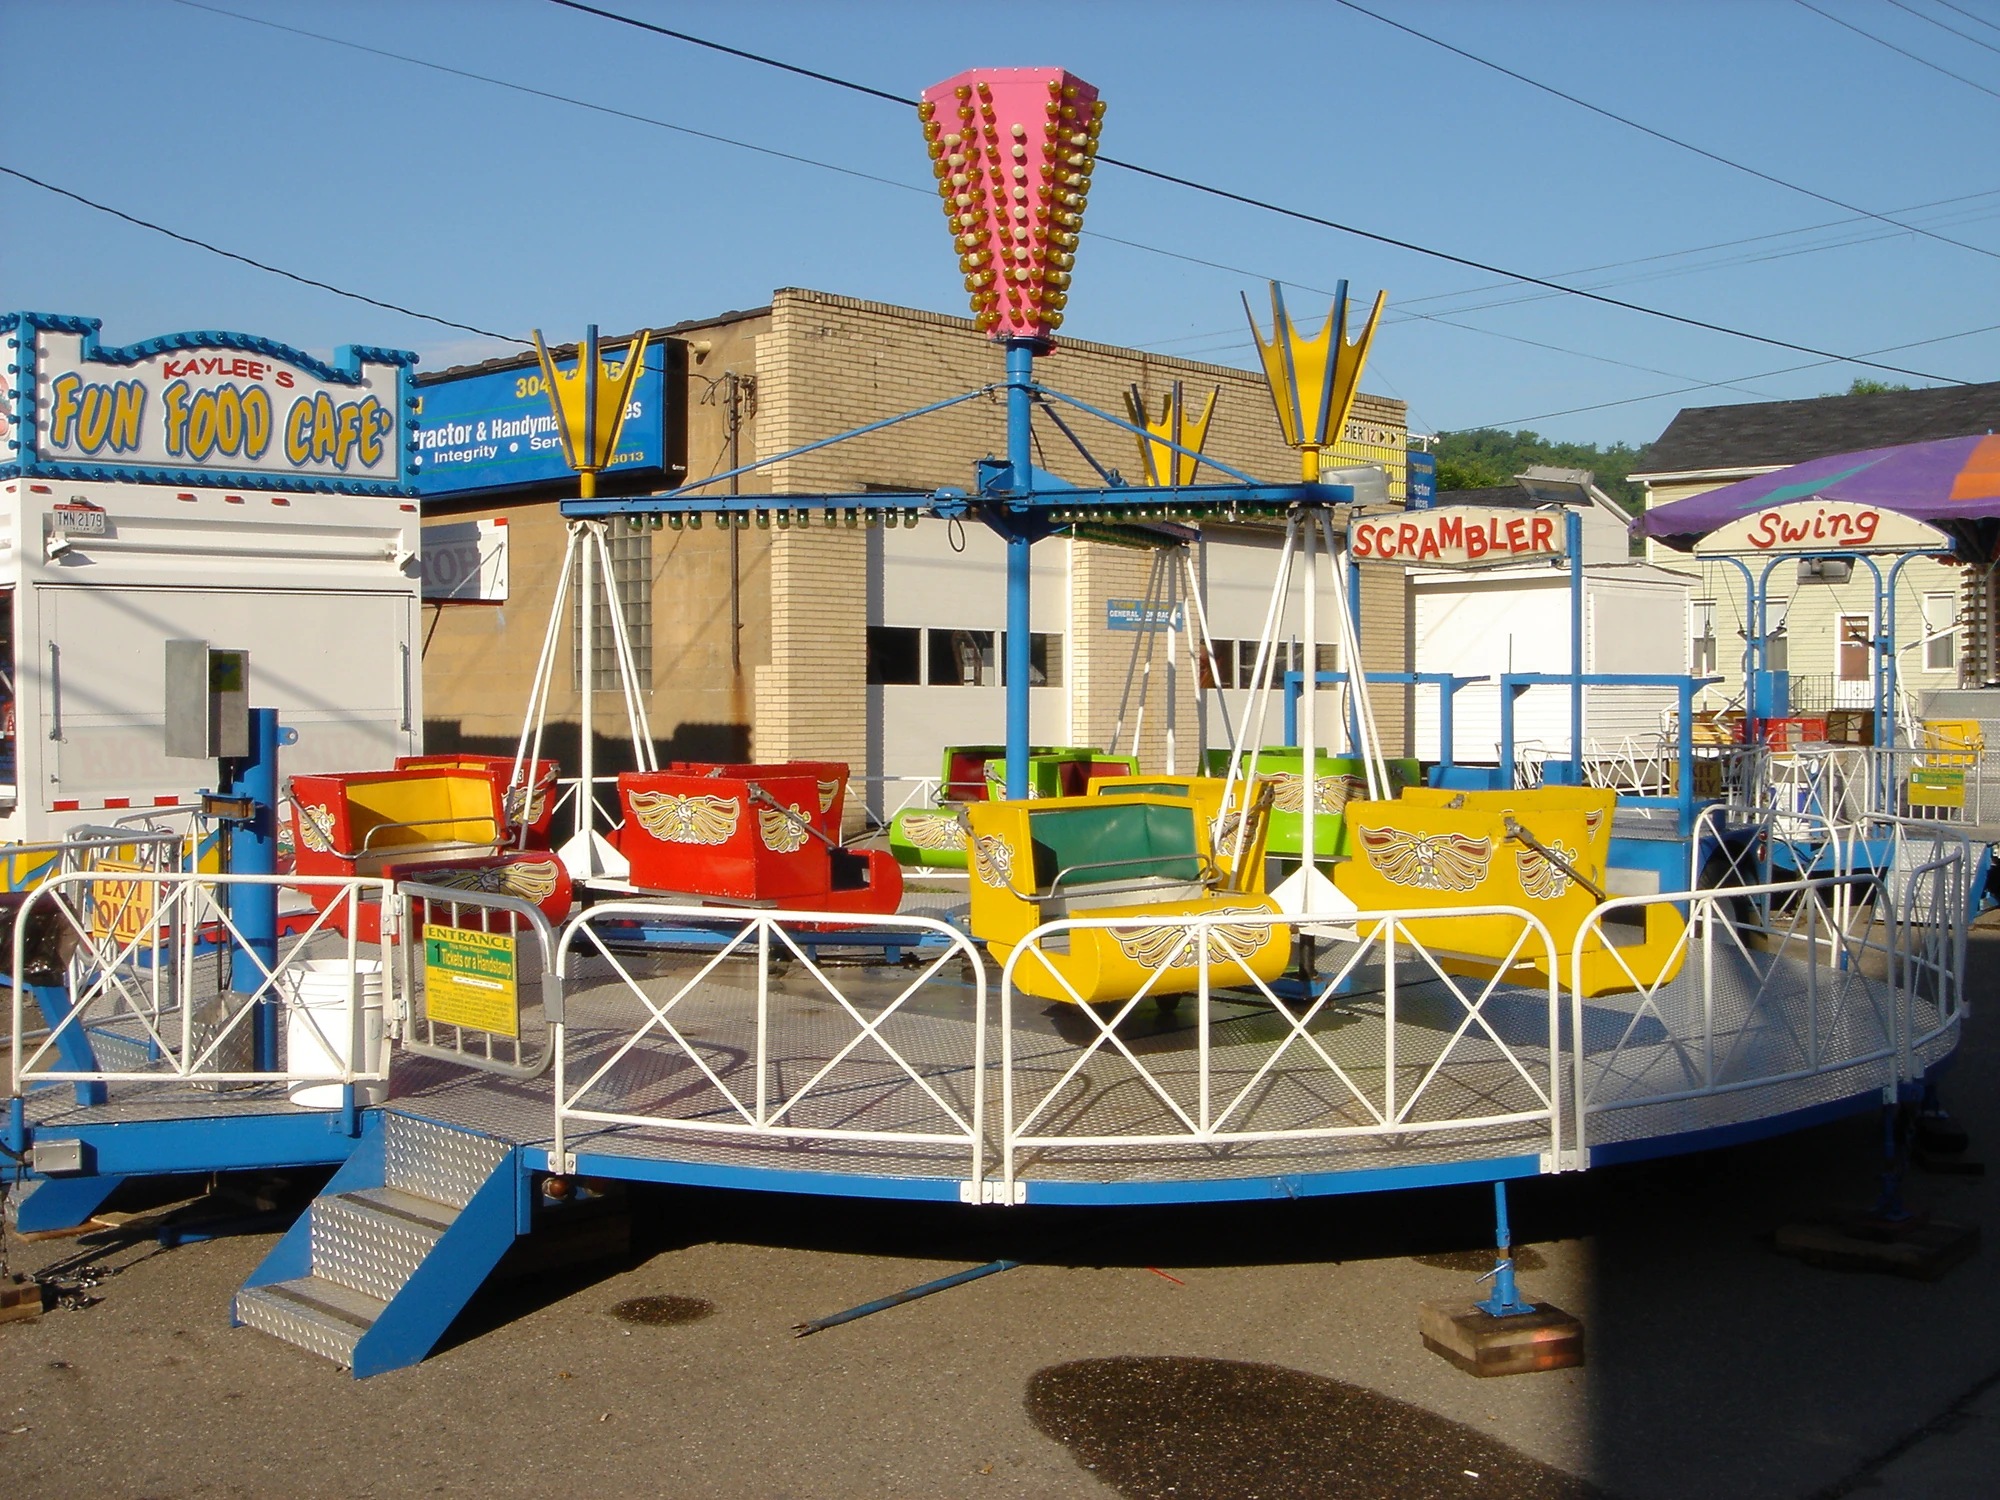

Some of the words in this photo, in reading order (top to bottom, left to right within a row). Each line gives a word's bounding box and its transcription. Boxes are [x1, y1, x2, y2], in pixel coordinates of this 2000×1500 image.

[162, 357, 295, 389] KAYLEE'S
[51, 372, 146, 455] FUN
[162, 378, 274, 463] FOOD
[476, 421, 487, 442] &
[434, 445, 498, 463] Integrity
[57, 511, 75, 527] TMN
[78, 512, 102, 527] 2179
[1747, 509, 1880, 549] Swing
[1352, 516, 1555, 560] SCRAMBLER
[1109, 610, 1139, 618] GENERAL
[98, 900, 149, 934] ONLY
[427, 926, 511, 950] ENTRANCE
[434, 942, 441, 963] 1
[441, 948, 464, 968] Tickets
[464, 955, 472, 969] or
[477, 953, 512, 980] Handstamp
